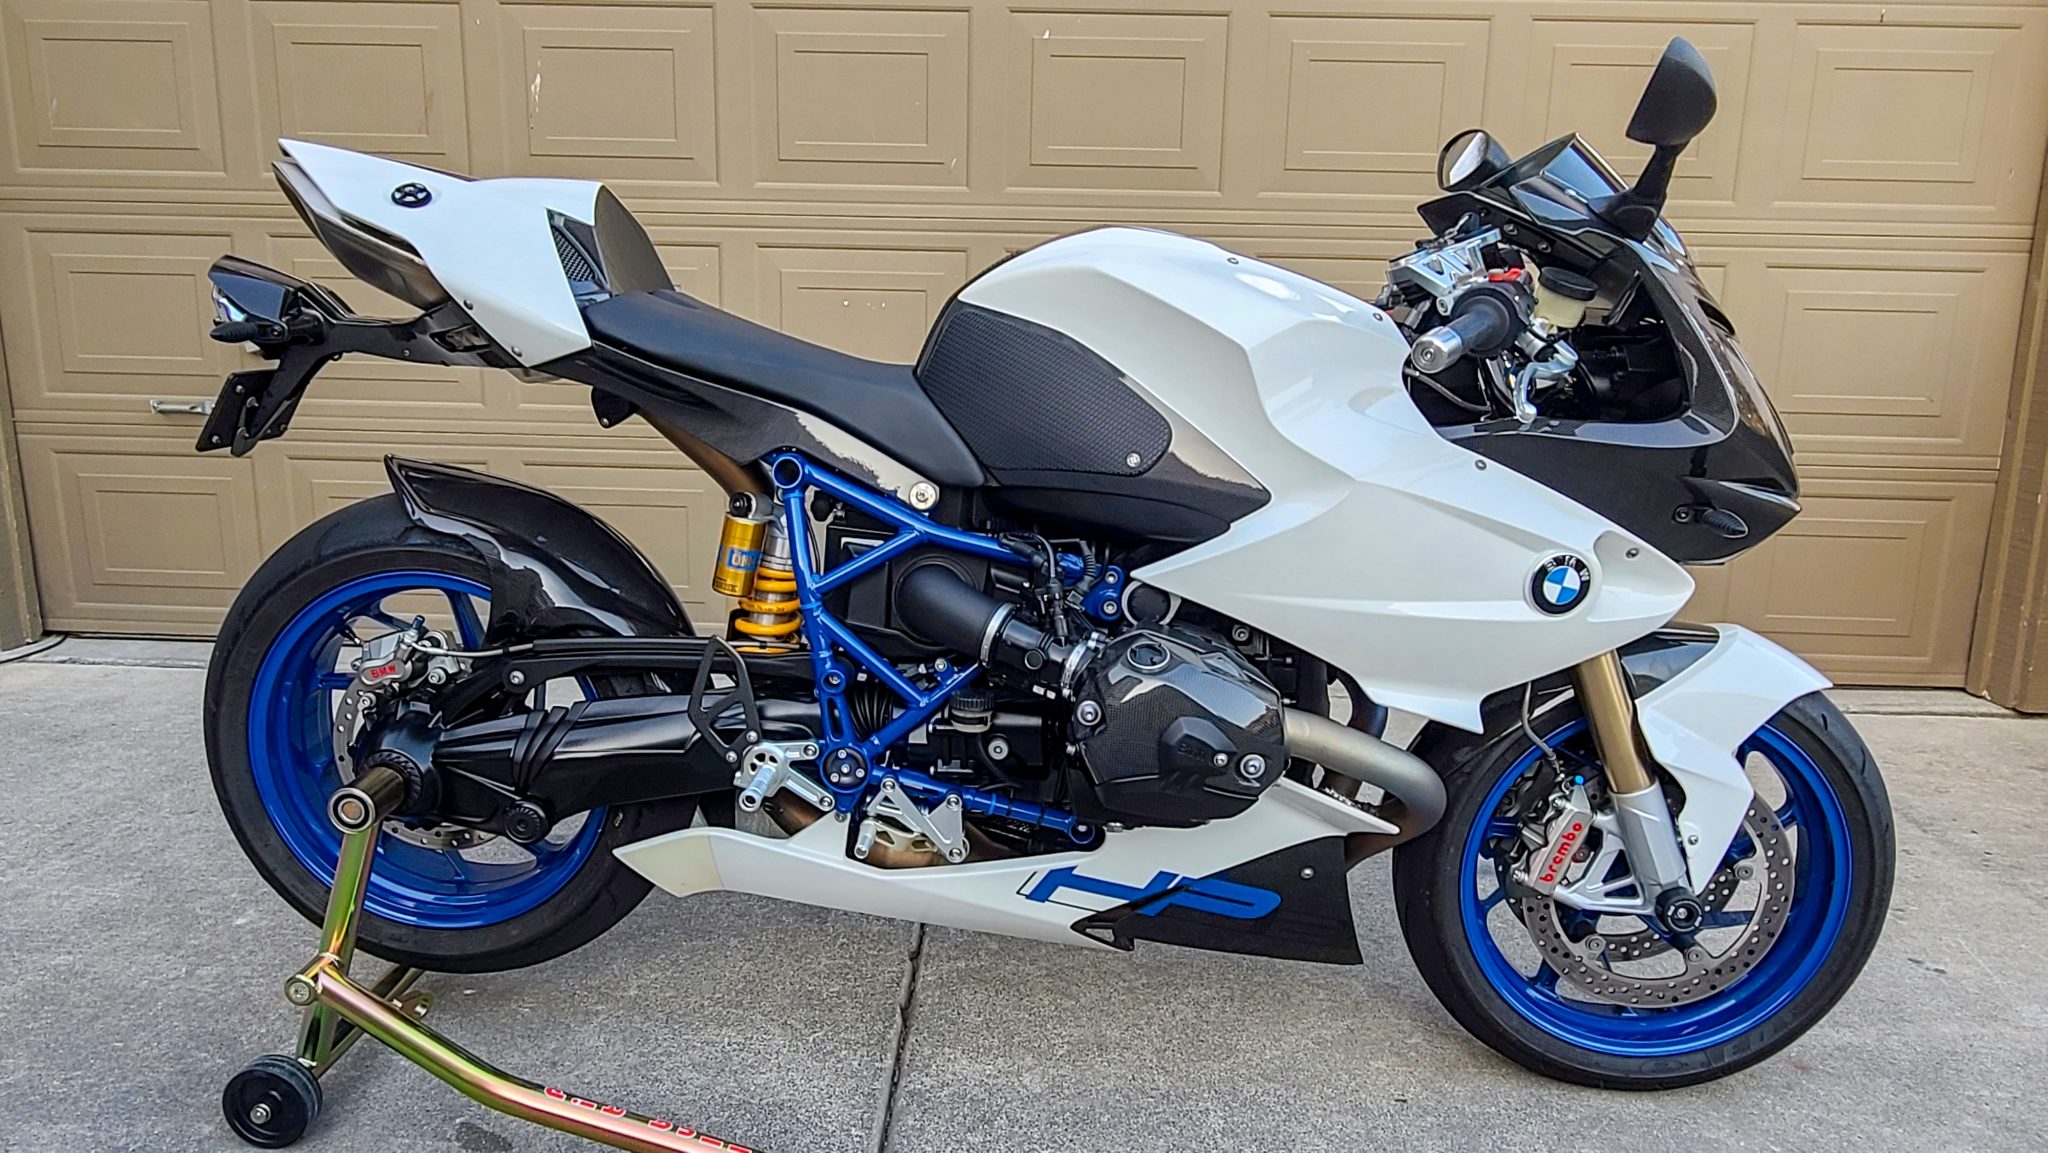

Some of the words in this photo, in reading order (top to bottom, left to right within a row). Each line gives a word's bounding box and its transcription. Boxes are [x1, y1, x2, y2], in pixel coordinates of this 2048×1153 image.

[1544, 555, 1590, 580] BMW
[370, 663, 396, 679] BMW
[1538, 822, 1583, 883] brembo
